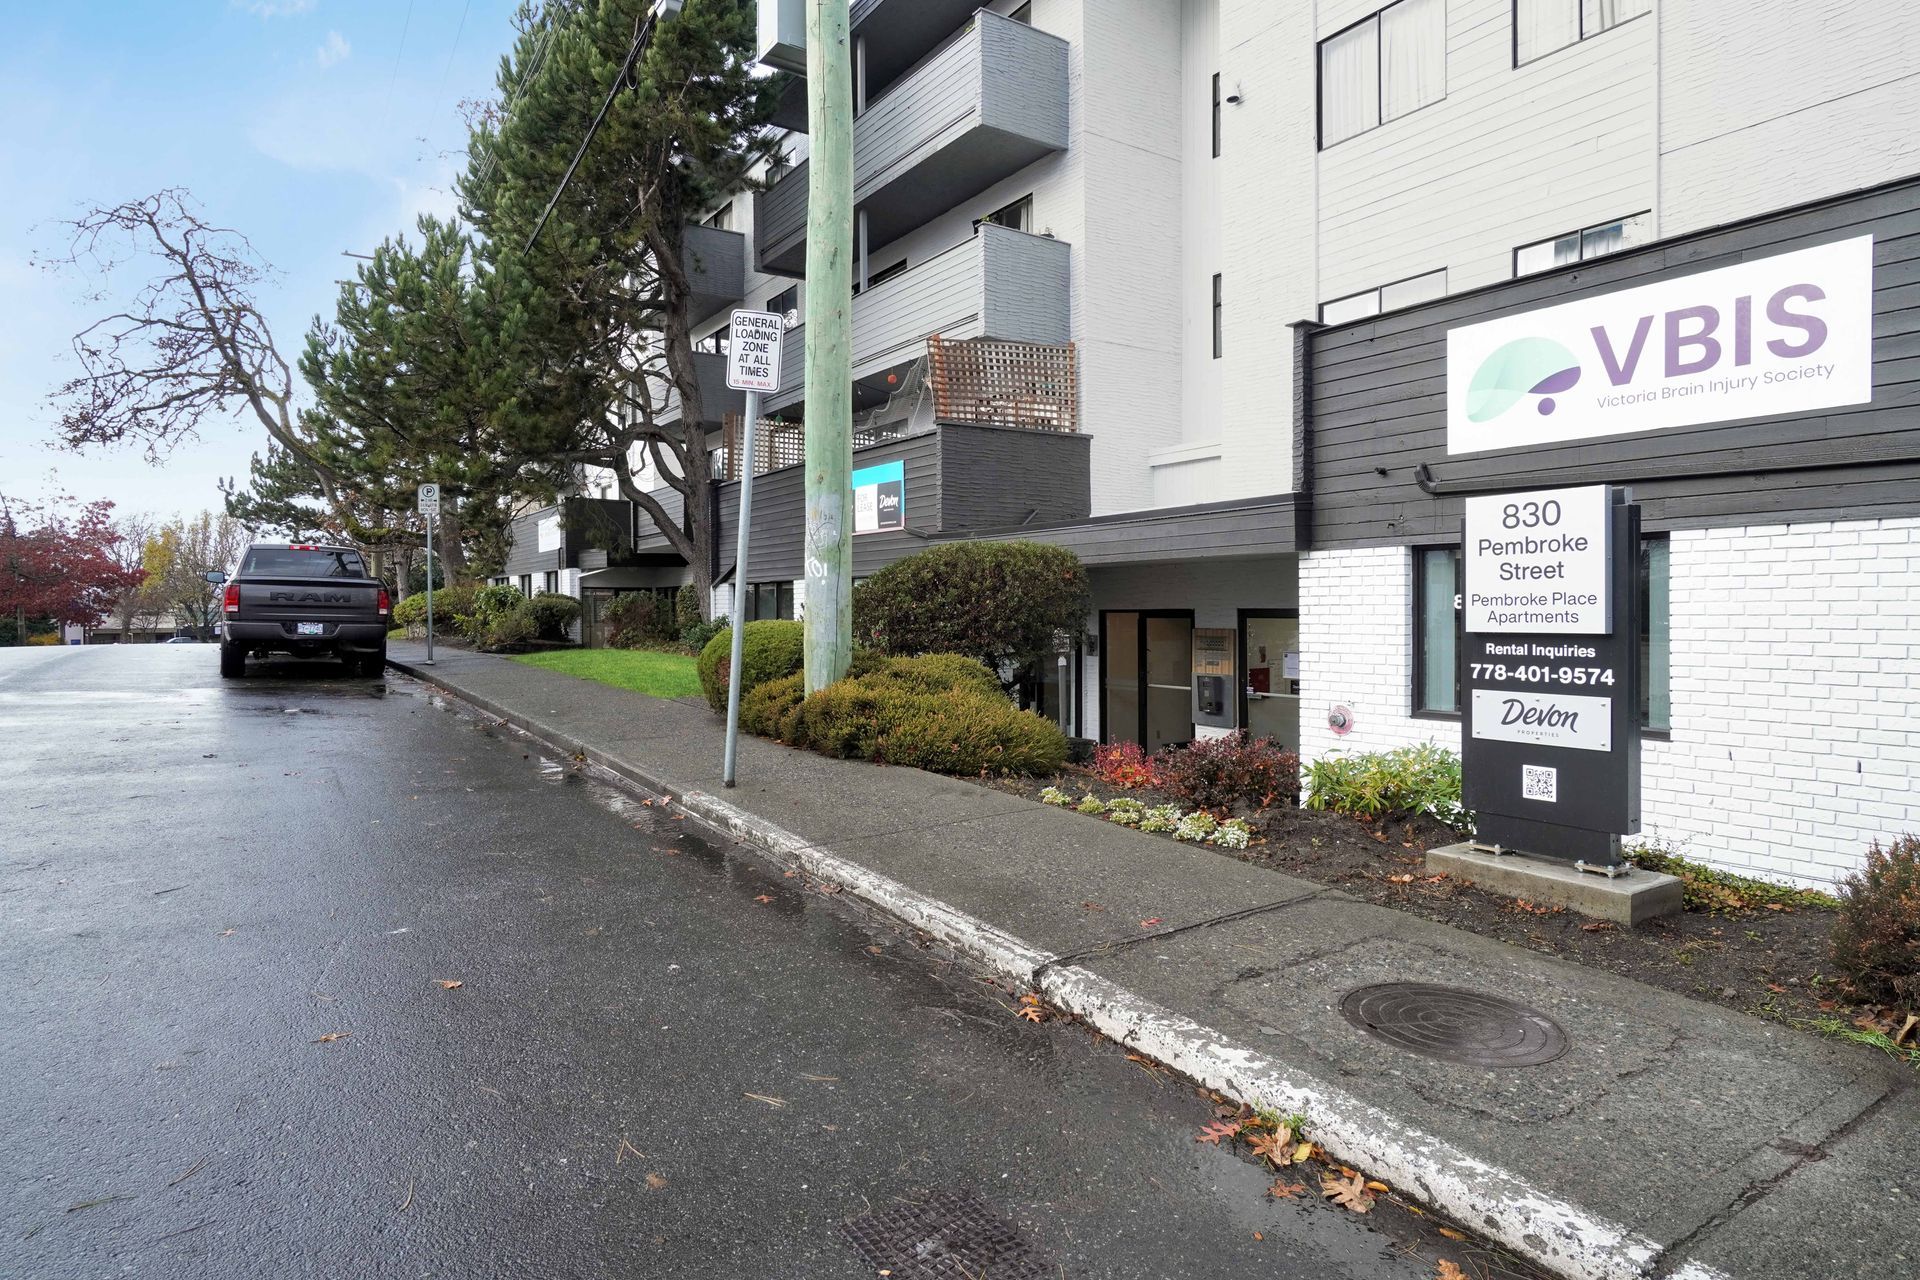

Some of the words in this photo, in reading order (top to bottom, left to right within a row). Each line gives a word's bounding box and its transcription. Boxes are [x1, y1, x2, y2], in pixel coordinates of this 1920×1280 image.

[735, 316, 779, 330] GENERAL
[735, 328, 778, 342] LOADING
[1590, 283, 1828, 387] VBIS
[742, 341, 769, 353] ZONE
[738, 353, 750, 363] AT
[753, 355, 771, 366] ALL
[739, 365, 769, 378] TIMES
[1596, 390, 1657, 409] Victoria
[1661, 379, 1704, 400] Brain
[1709, 373, 1758, 395] Injury
[1763, 363, 1835, 384] Society
[857, 501, 873, 513] LEASE
[879, 494, 899, 509] Devon
[1502, 500, 1561, 529] 830
[1478, 533, 1588, 556] Pembroke
[1499, 561, 1565, 581] Street
[269, 591, 352, 603] RAM
[1471, 593, 1548, 606] Pembroke
[1552, 592, 1598, 605] Place
[1487, 611, 1580, 626] Apartments
[1485, 643, 1529, 656] Rental
[1532, 645, 1597, 660] Inquiries
[1470, 663, 1616, 686] 778-401-9574
[1500, 698, 1579, 733] Devon
[1517, 729, 1560, 738] PROPERTIES
